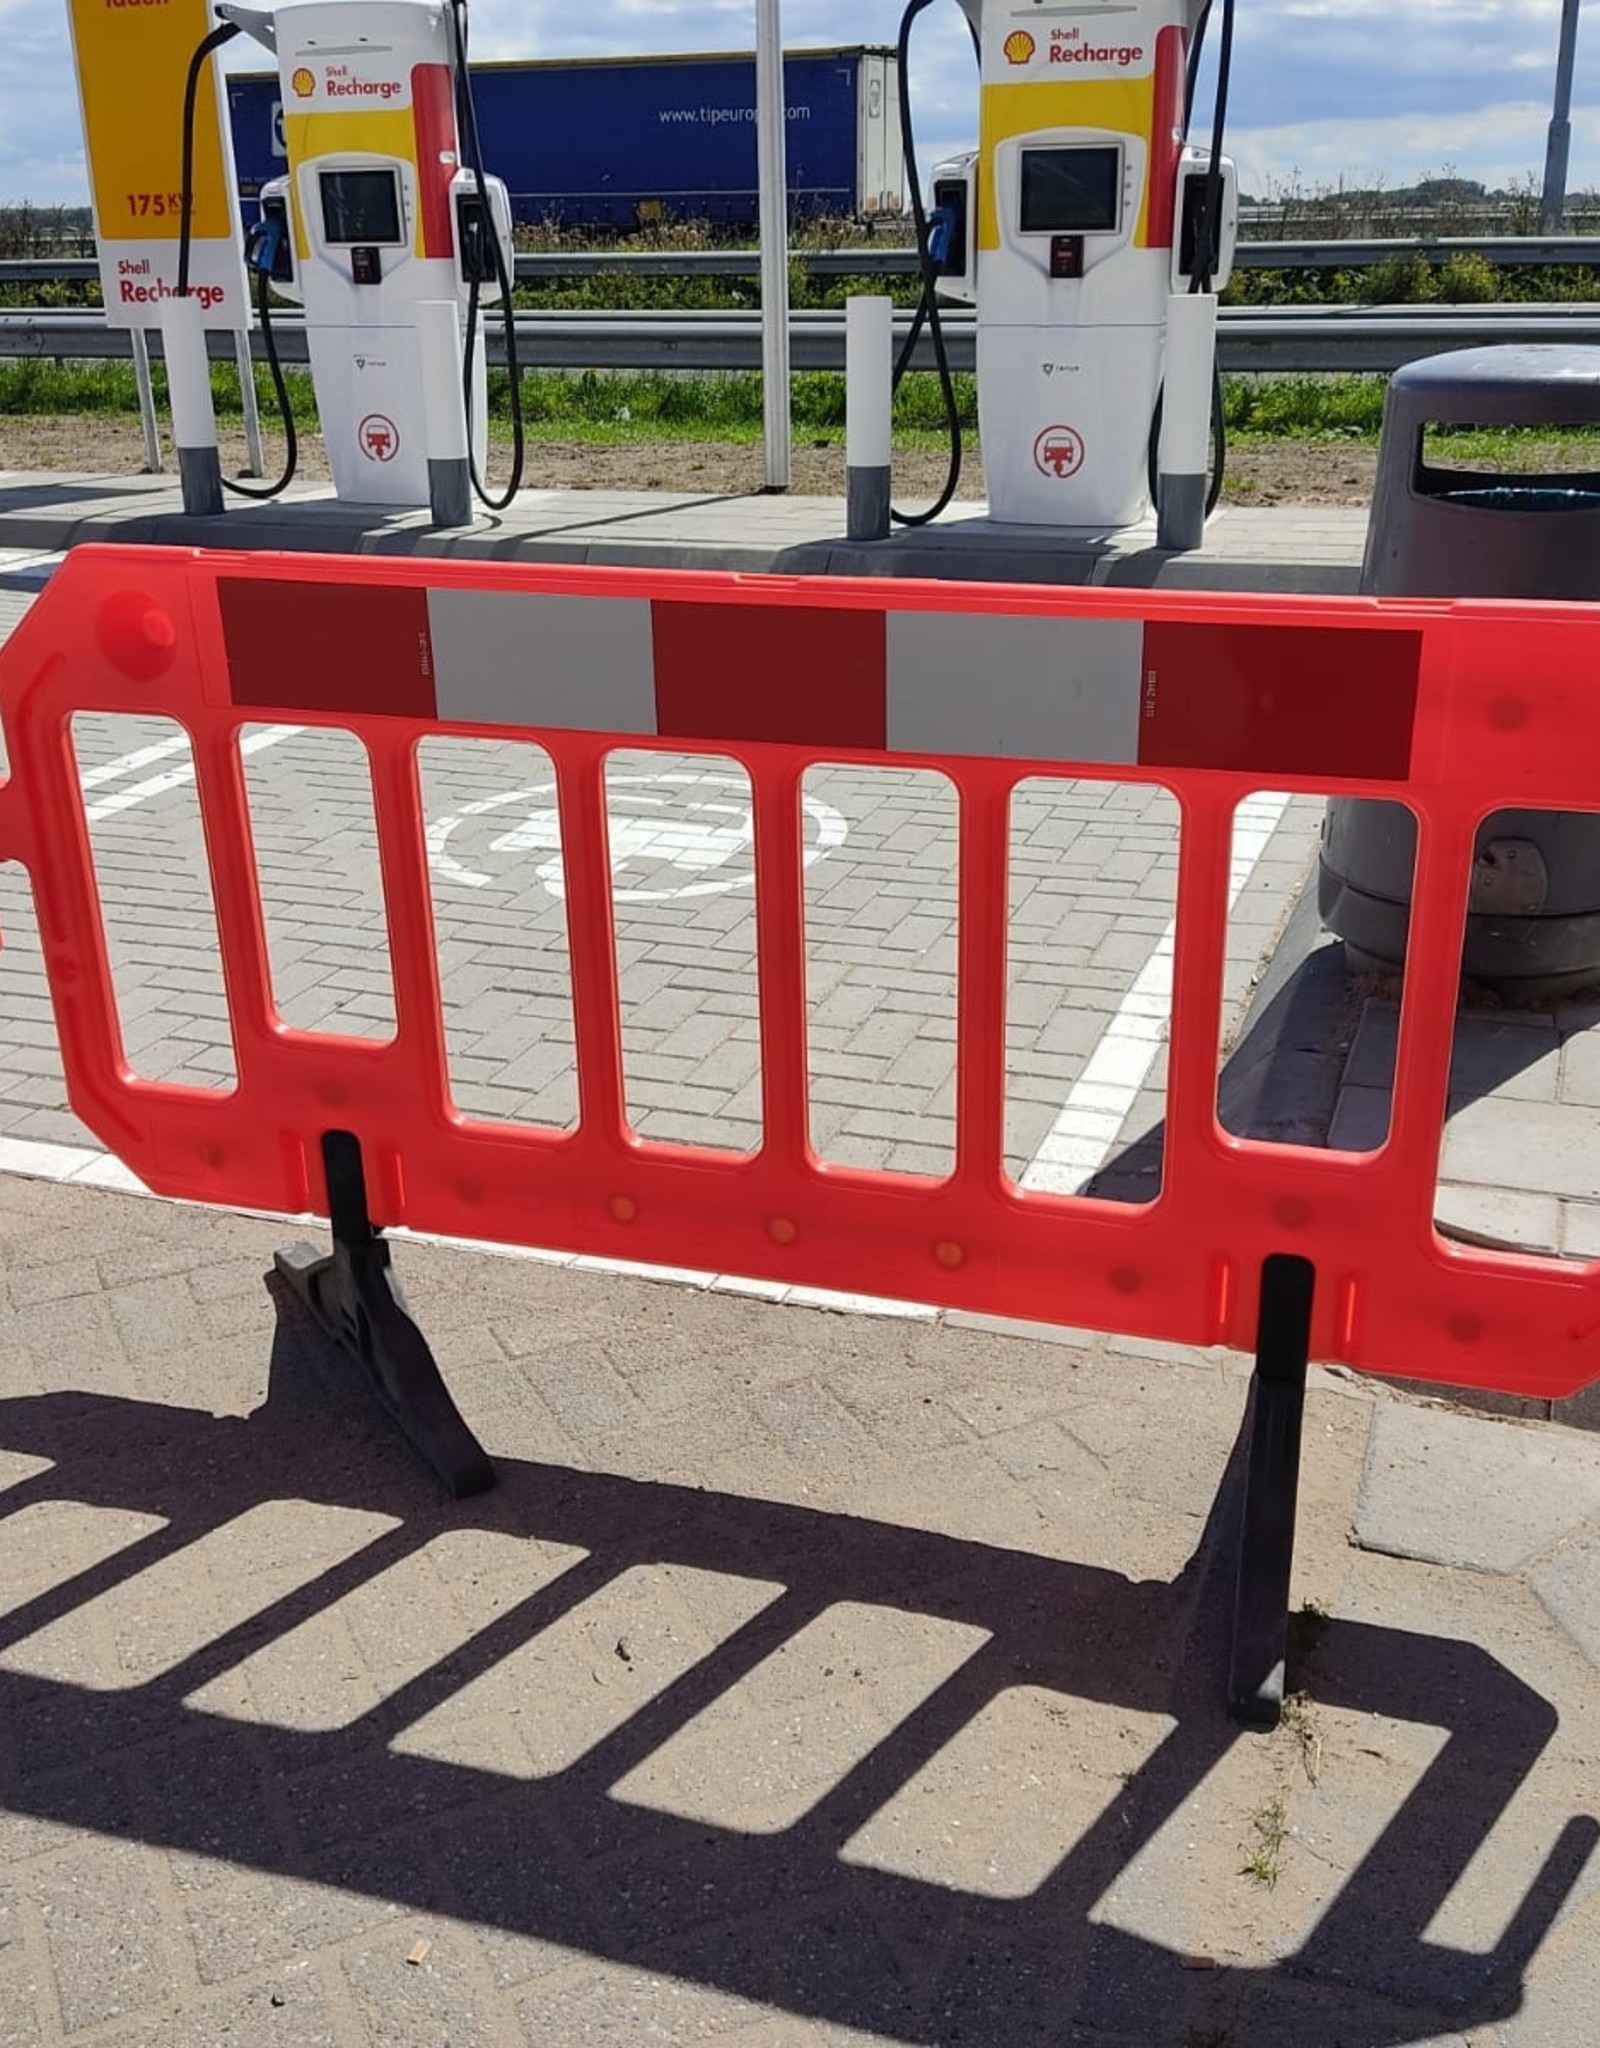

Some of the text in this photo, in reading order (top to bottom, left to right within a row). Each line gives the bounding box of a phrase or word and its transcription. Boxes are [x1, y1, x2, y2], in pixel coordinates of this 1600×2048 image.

[1050, 27, 1079, 41] Shell
[1049, 42, 1143, 66] Recharge
[326, 77, 402, 98] Recharge
[658, 105, 811, 127] www.tipeuroom
[127, 193, 166, 216] 175
[118, 259, 150, 275] Shell
